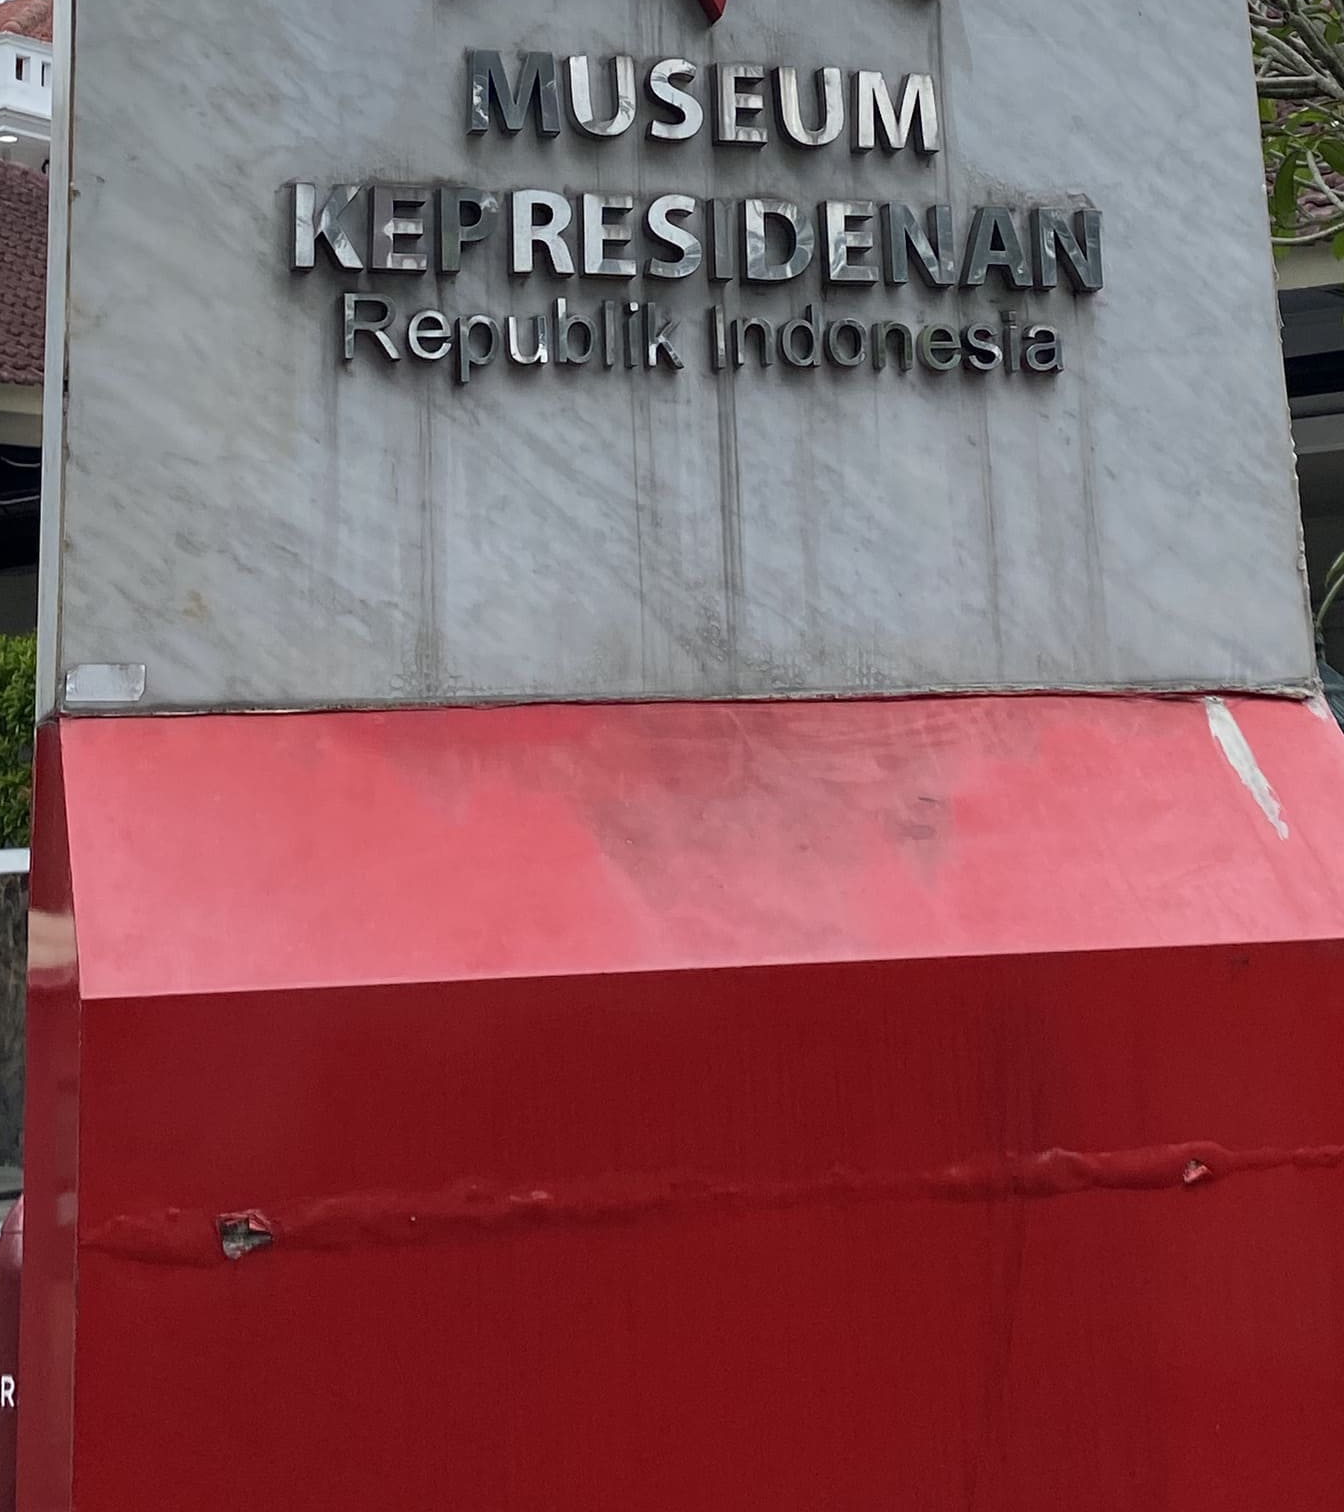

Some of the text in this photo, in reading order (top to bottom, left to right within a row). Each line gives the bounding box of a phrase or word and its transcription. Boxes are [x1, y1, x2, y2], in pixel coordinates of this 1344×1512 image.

[465, 48, 940, 155] MUSEUM
[290, 181, 1104, 291] KEPRESIDENAN
[341, 292, 1065, 384] Republik Indonesia
